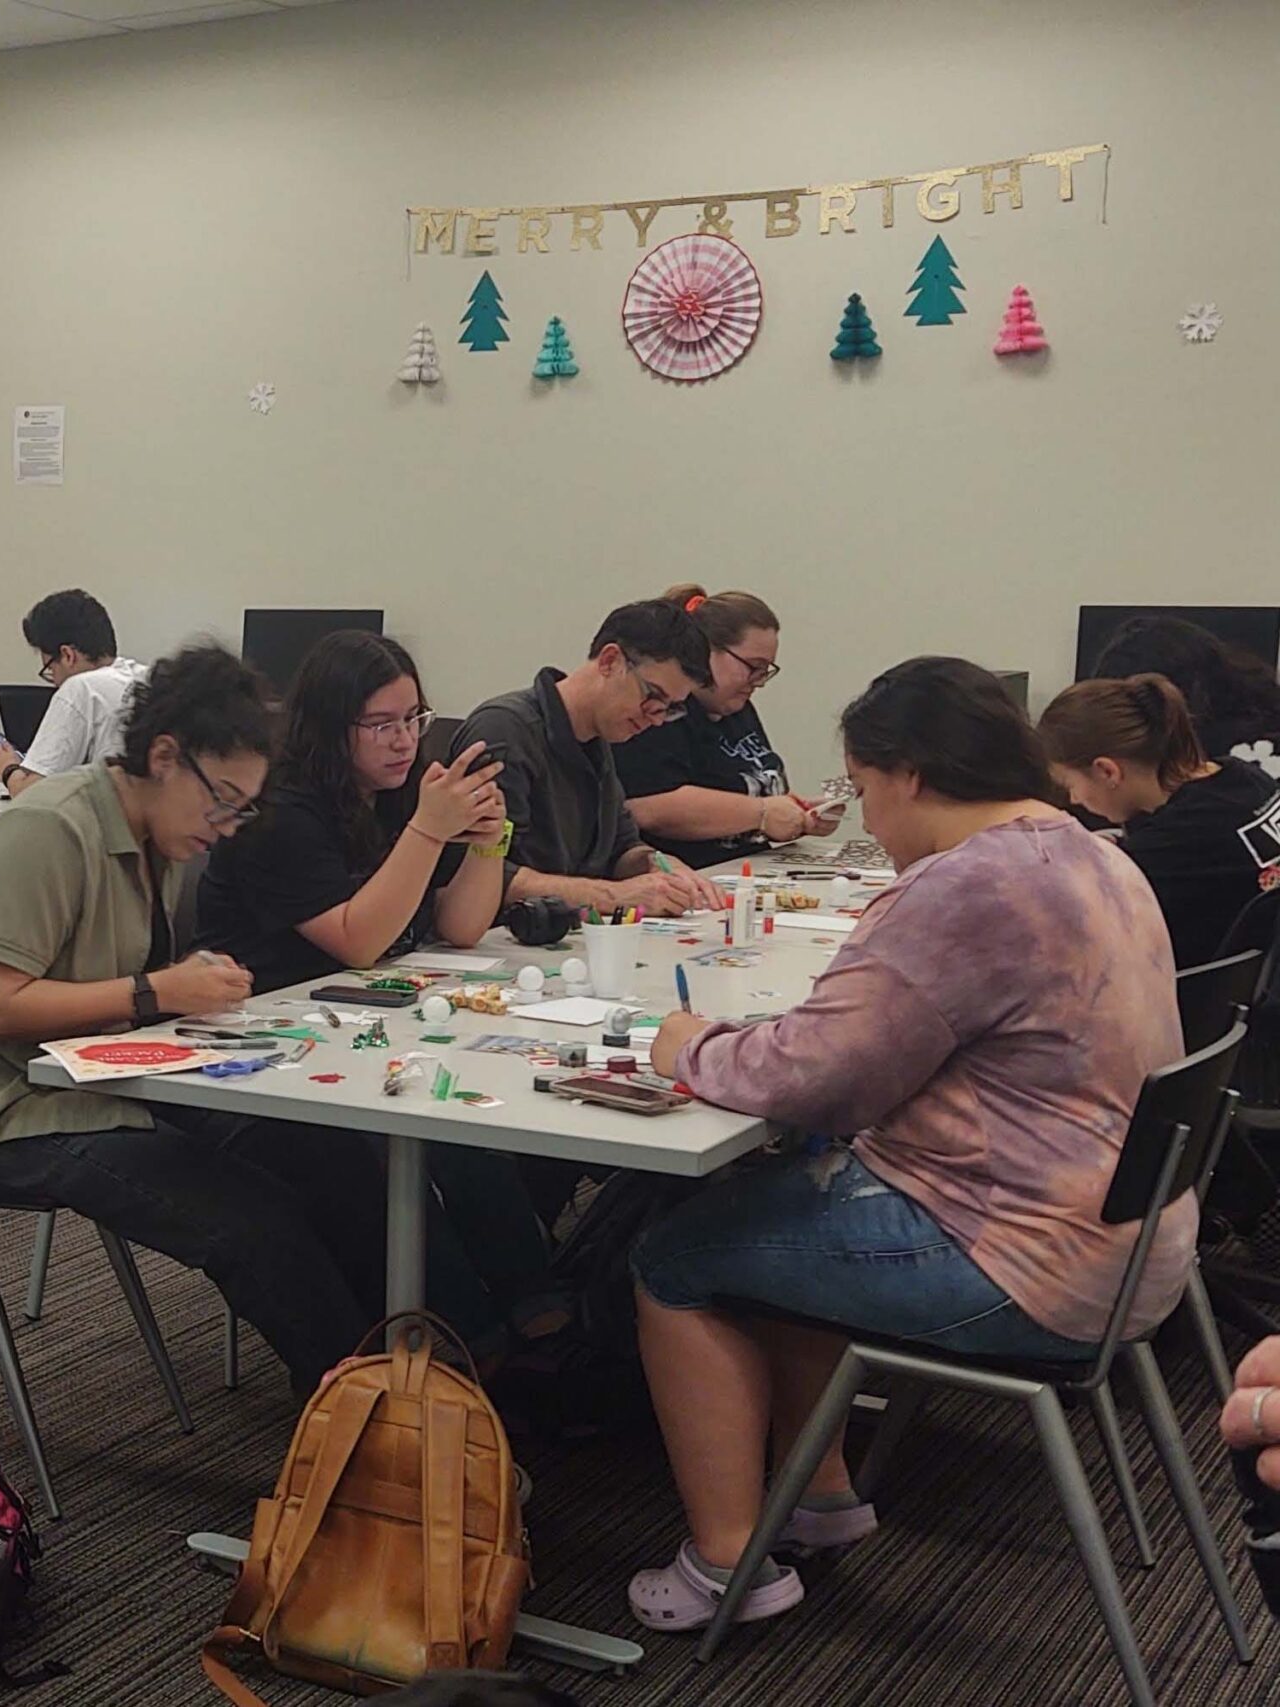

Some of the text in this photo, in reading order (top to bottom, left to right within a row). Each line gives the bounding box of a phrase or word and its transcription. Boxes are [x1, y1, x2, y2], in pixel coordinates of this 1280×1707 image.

[416, 152, 1085, 254] MERRY & BRIGHT
